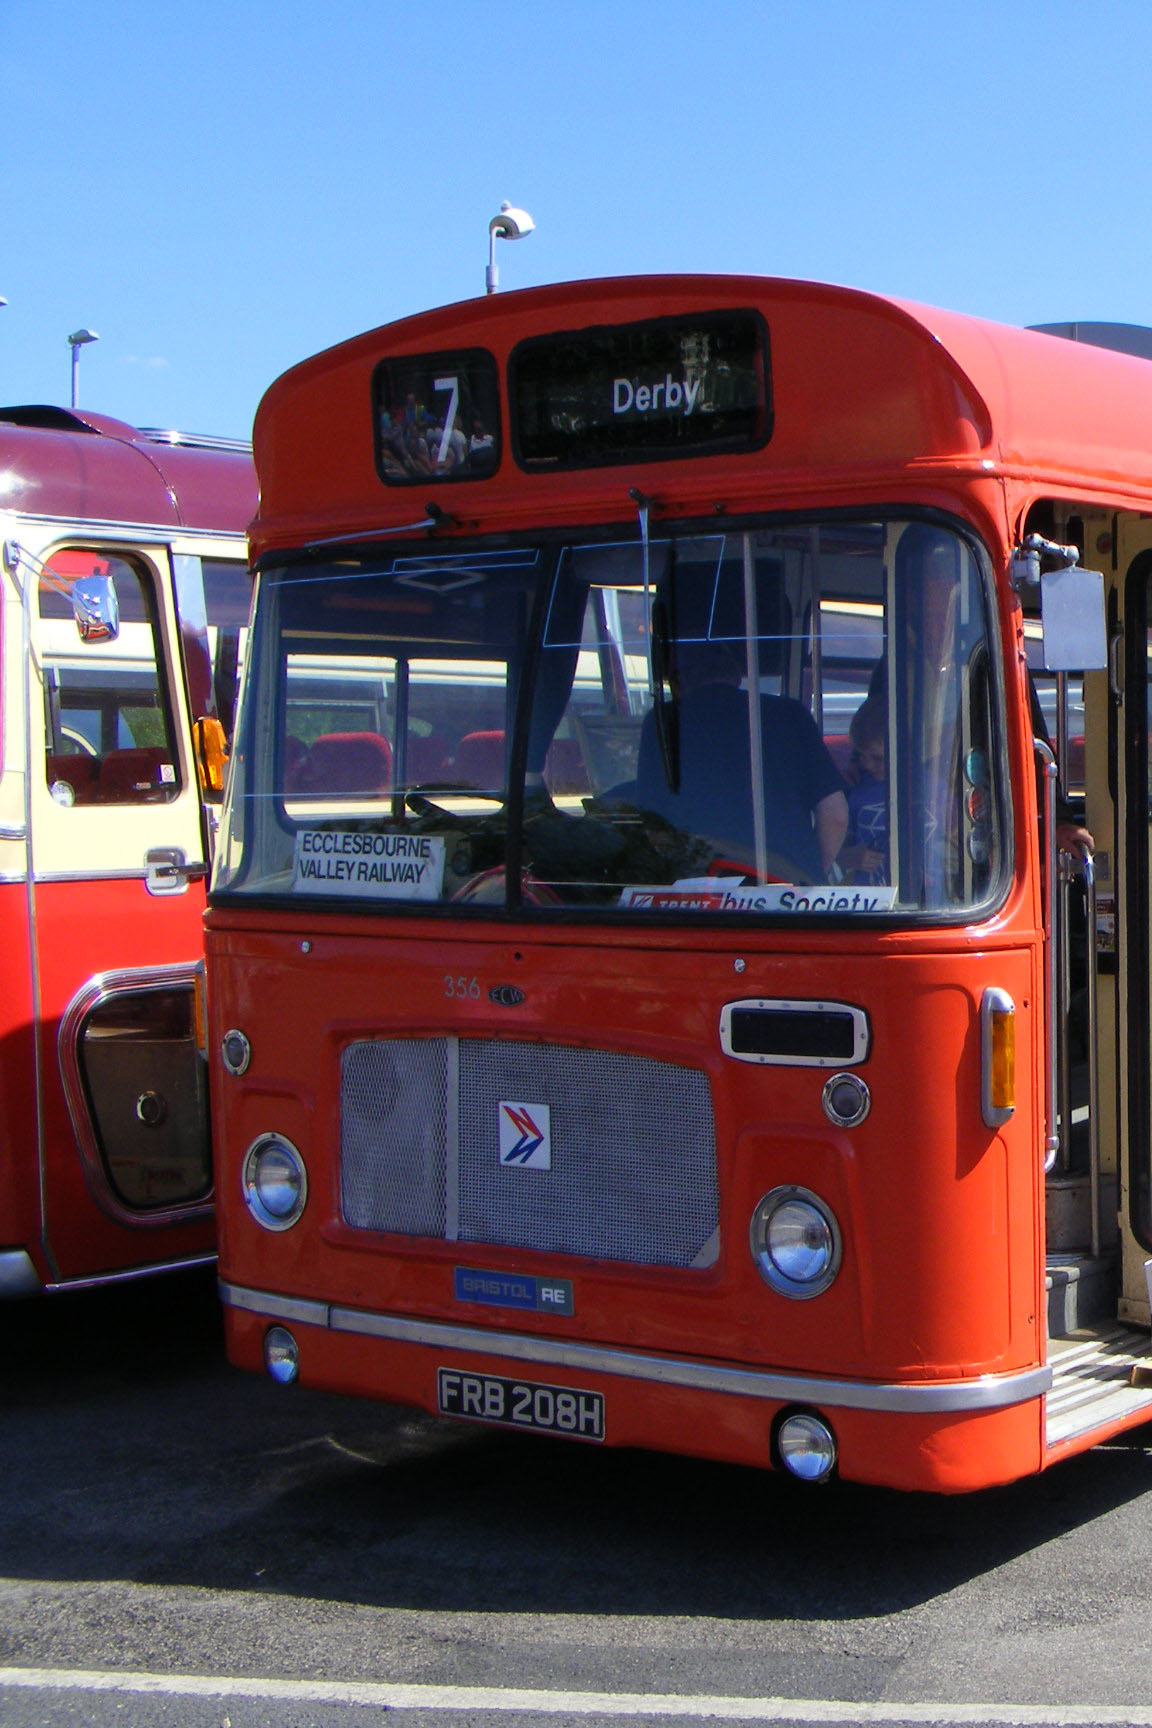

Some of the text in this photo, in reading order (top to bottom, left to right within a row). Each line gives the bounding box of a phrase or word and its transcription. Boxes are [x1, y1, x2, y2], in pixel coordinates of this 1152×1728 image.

[613, 373, 700, 416] Derby
[434, 376, 458, 463] 7
[303, 833, 431, 858] ECCLESBOURNE
[300, 860, 425, 883] VALLEY RAILWAY
[779, 891, 878, 911] Society
[444, 975, 480, 1000] 356
[462, 1277, 566, 1304] BRISTOL AE
[441, 1374, 600, 1435] FRB 208H
